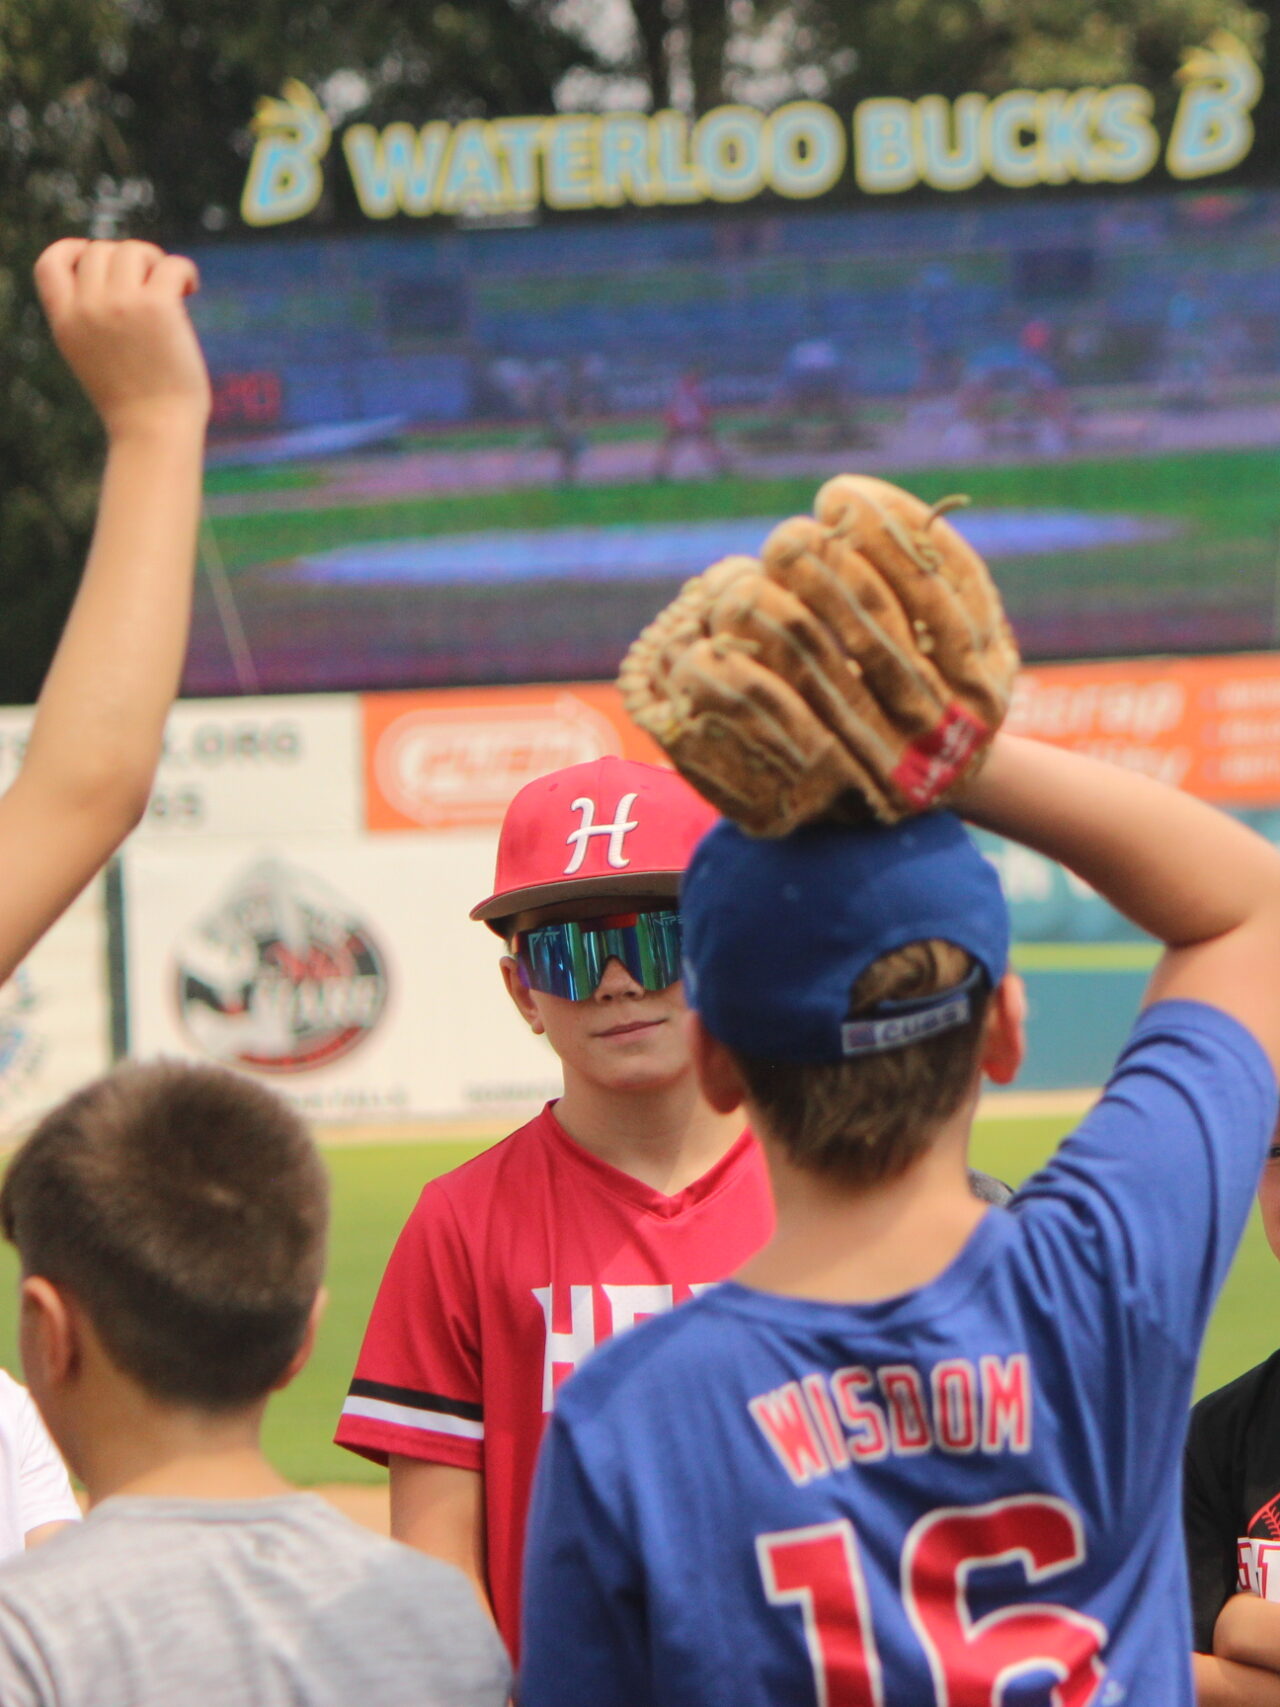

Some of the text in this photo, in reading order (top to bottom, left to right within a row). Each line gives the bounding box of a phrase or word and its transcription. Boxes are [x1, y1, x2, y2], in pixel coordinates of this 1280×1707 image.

[344, 101, 846, 220] WATERLOO
[854, 84, 1158, 194] BUCKS
[162, 719, 304, 770] .ORG
[565, 792, 638, 875] H
[748, 1353, 1032, 1487] WISDOM
[755, 1494, 1108, 1707] 16
